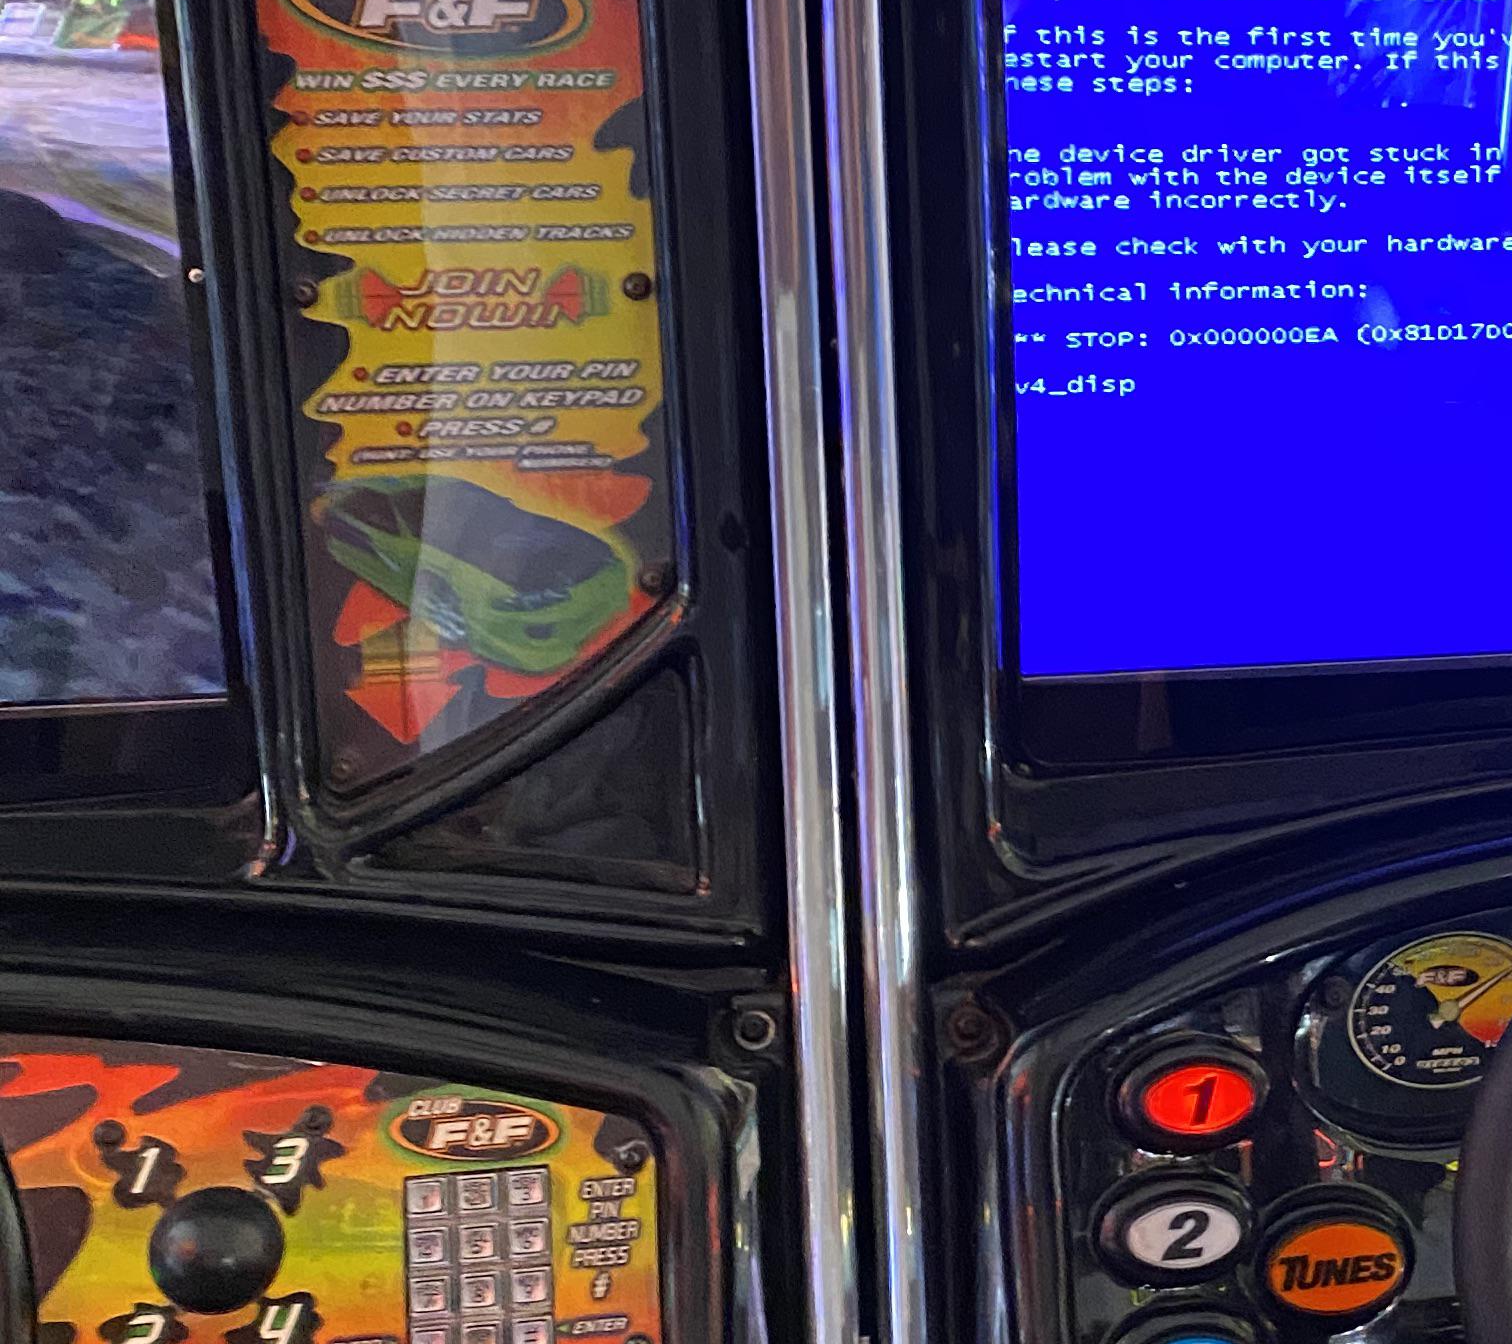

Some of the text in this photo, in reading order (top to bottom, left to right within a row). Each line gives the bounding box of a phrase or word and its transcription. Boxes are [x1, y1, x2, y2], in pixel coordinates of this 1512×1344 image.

[1036, 25, 1105, 45] this
[1127, 25, 1159, 45] is
[1181, 27, 1230, 46] the
[1248, 27, 1331, 47] first
[1350, 27, 1418, 47] time
[297, 72, 354, 90] WIN
[436, 72, 530, 89] EVERY
[537, 71, 613, 89] RACE
[1093, 76, 1194, 95] steps:
[314, 109, 542, 126] SAVE YOUR STATS
[1059, 143, 1164, 163] device
[1181, 143, 1282, 163] driver
[1302, 145, 1350, 165] got
[1370, 144, 1449, 162] stuck
[1470, 143, 1500, 161] in
[1150, 189, 1348, 212] incorrectly.
[1013, 280, 1368, 303] echnical information:
[1065, 326, 1339, 348] STOP: 0x000000EA
[376, 360, 637, 384] ENTER YOUR PIN
[1016, 375, 1136, 396] v4_disp
[1184, 1076, 1217, 1126] 1
[429, 1116, 535, 1150] F&F
[131, 1147, 161, 1196] 1
[262, 1137, 309, 1185] 3
[581, 1178, 635, 1199] ENTER
[1161, 1210, 1211, 1261] 2
[1277, 1254, 1396, 1290] TUNES
